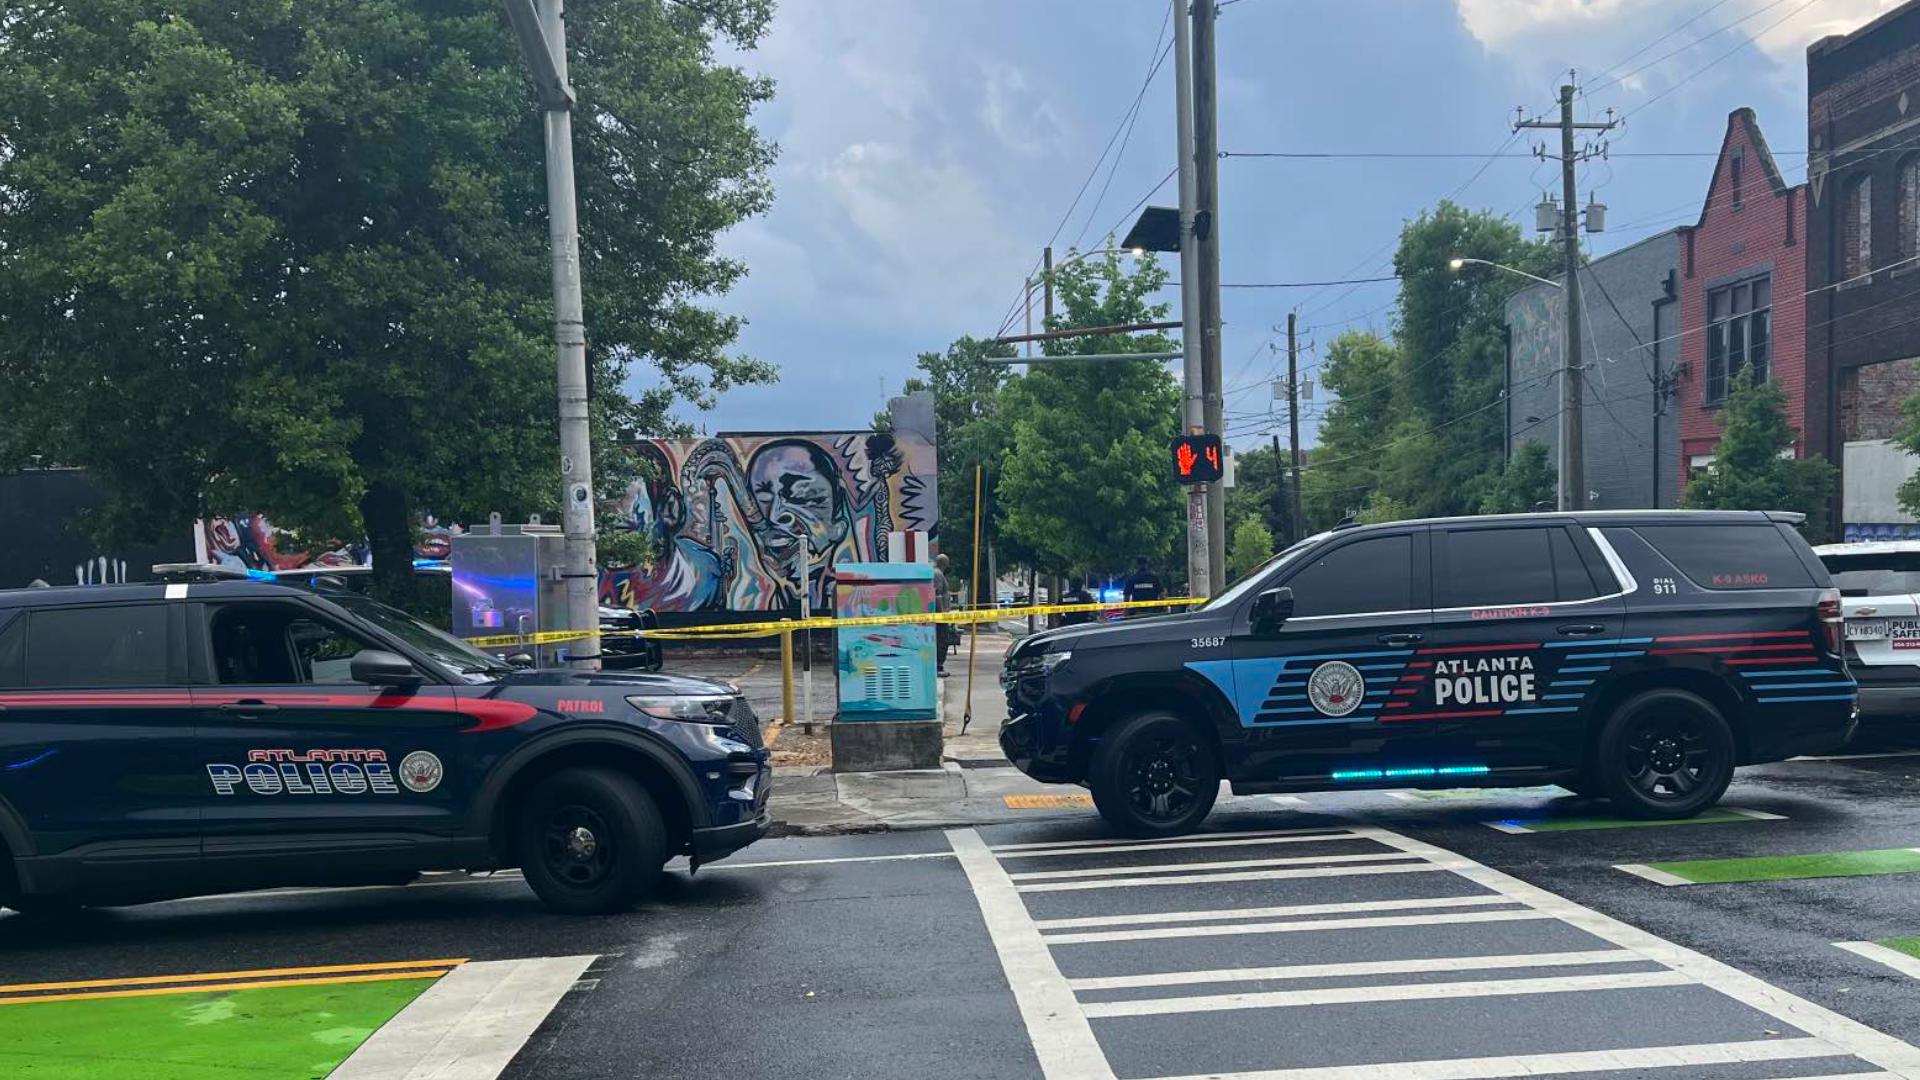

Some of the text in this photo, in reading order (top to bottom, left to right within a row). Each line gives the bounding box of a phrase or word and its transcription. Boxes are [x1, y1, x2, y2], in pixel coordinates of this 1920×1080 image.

[1206, 445, 1218, 471] 4
[1654, 584, 1676, 594] 911
[1471, 608, 1527, 620] CAUTION
[1191, 636, 1226, 648] 35687
[1435, 656, 1534, 674] ATLANTA
[1435, 674, 1536, 705] POLICE
[557, 699, 605, 713] PATROL
[248, 749, 388, 762] ATLANTA
[206, 763, 400, 795] POLICE
